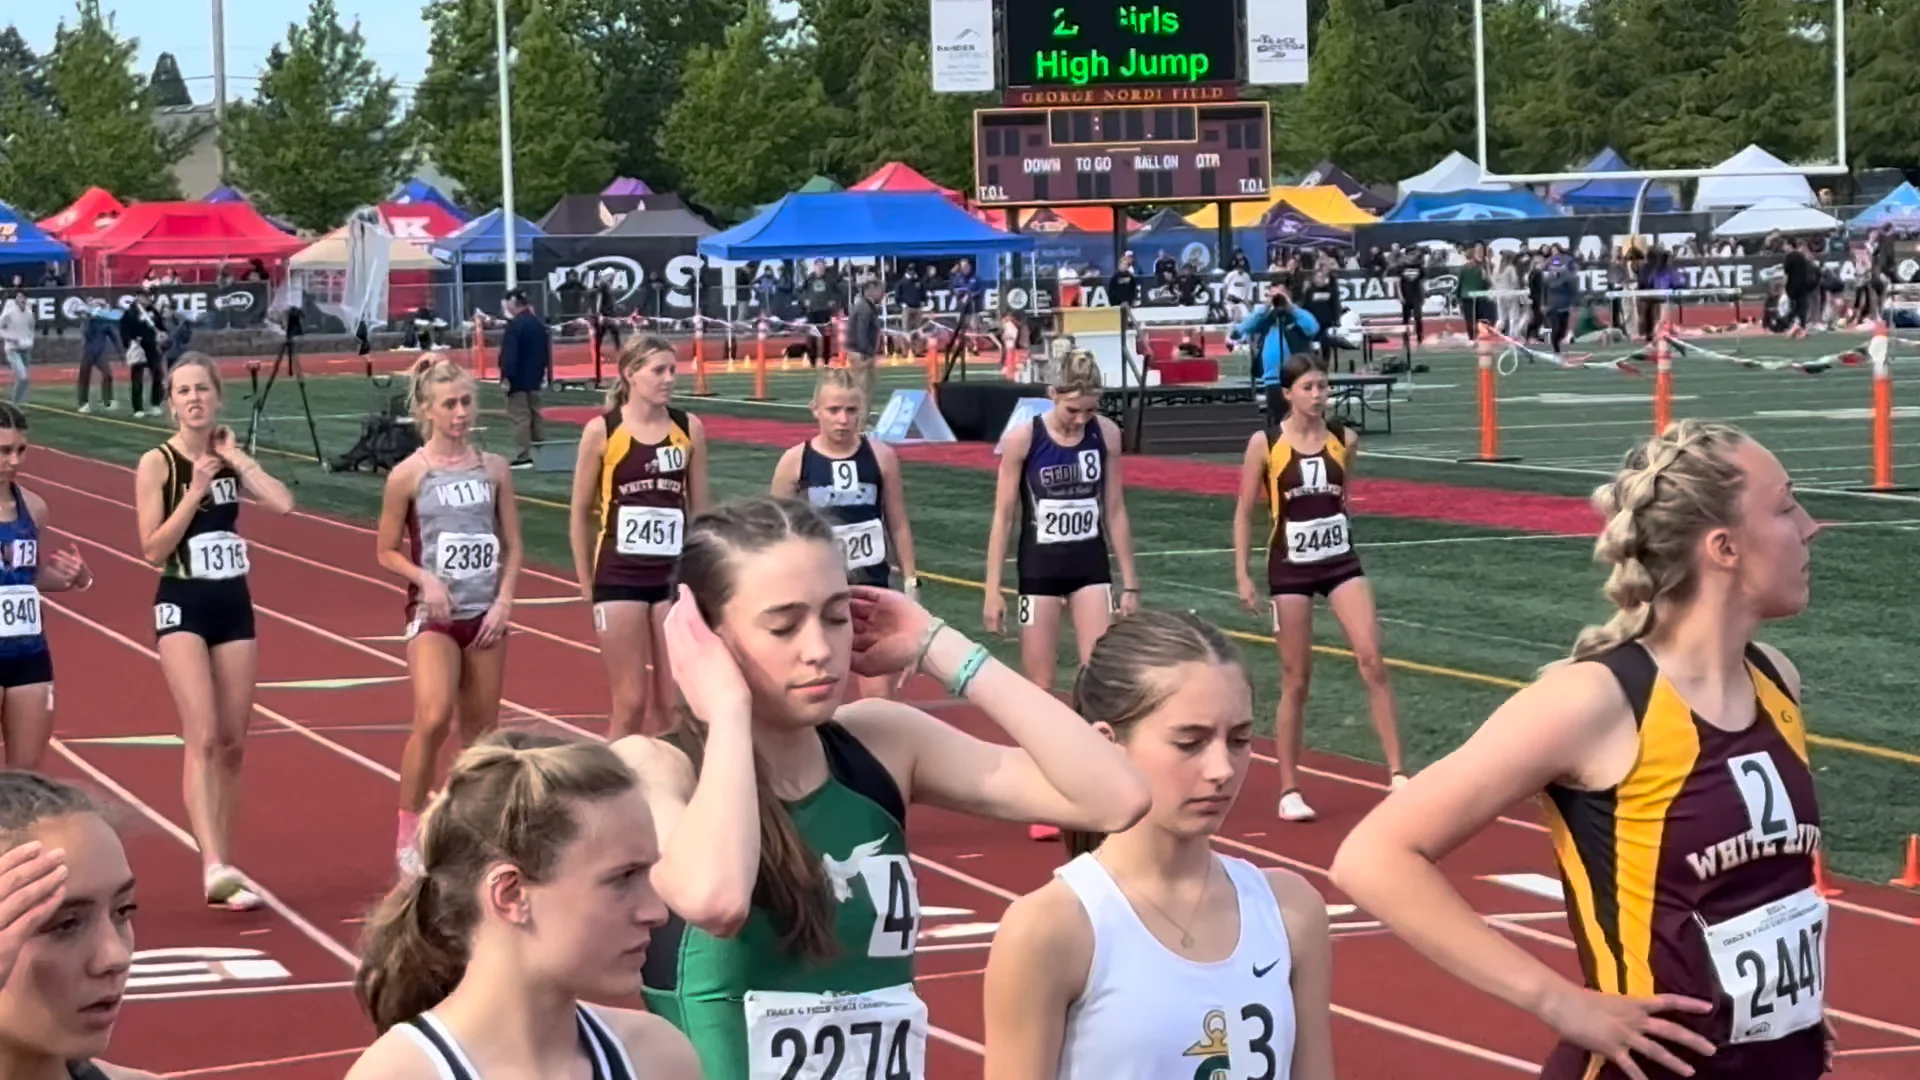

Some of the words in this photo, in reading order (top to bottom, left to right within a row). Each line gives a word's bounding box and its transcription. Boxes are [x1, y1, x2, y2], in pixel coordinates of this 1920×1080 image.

[1037, 49, 1109, 84] High
[1119, 48, 1209, 82] Jump
[1021, 91, 1094, 104] GEORGE
[1172, 87, 1224, 100] FIELD
[1023, 158, 1061, 173] DOWN
[1076, 157, 1092, 171] TO
[1094, 156, 1112, 171] GO
[1134, 156, 1160, 170] BALL
[1163, 154, 1179, 169] ON
[1196, 153, 1220, 169] QTR
[1338, 277, 1401, 299] STAT
[664, 446, 683, 469] 10
[1084, 452, 1098, 480] 8
[838, 463, 853, 490] 9
[1306, 460, 1319, 487] 7
[216, 480, 236, 501] 12
[453, 482, 475, 503] 11
[625, 518, 677, 546] 2451
[1045, 510, 1094, 536] 2009
[848, 533, 873, 560] 20
[1294, 525, 1343, 553] 2449
[19, 541, 35, 565] 13
[201, 544, 246, 571] 1315
[444, 542, 494, 570] 2338
[2, 597, 37, 626] 840
[159, 605, 176, 626] 12
[1019, 597, 1030, 624] 8
[1741, 759, 1788, 836] 2
[1685, 828, 1777, 880] WHITE
[883, 860, 915, 950] 4
[1735, 919, 1824, 1019] 2447
[771, 1019, 911, 1080] 2274
[1240, 1003, 1276, 1080] 3
